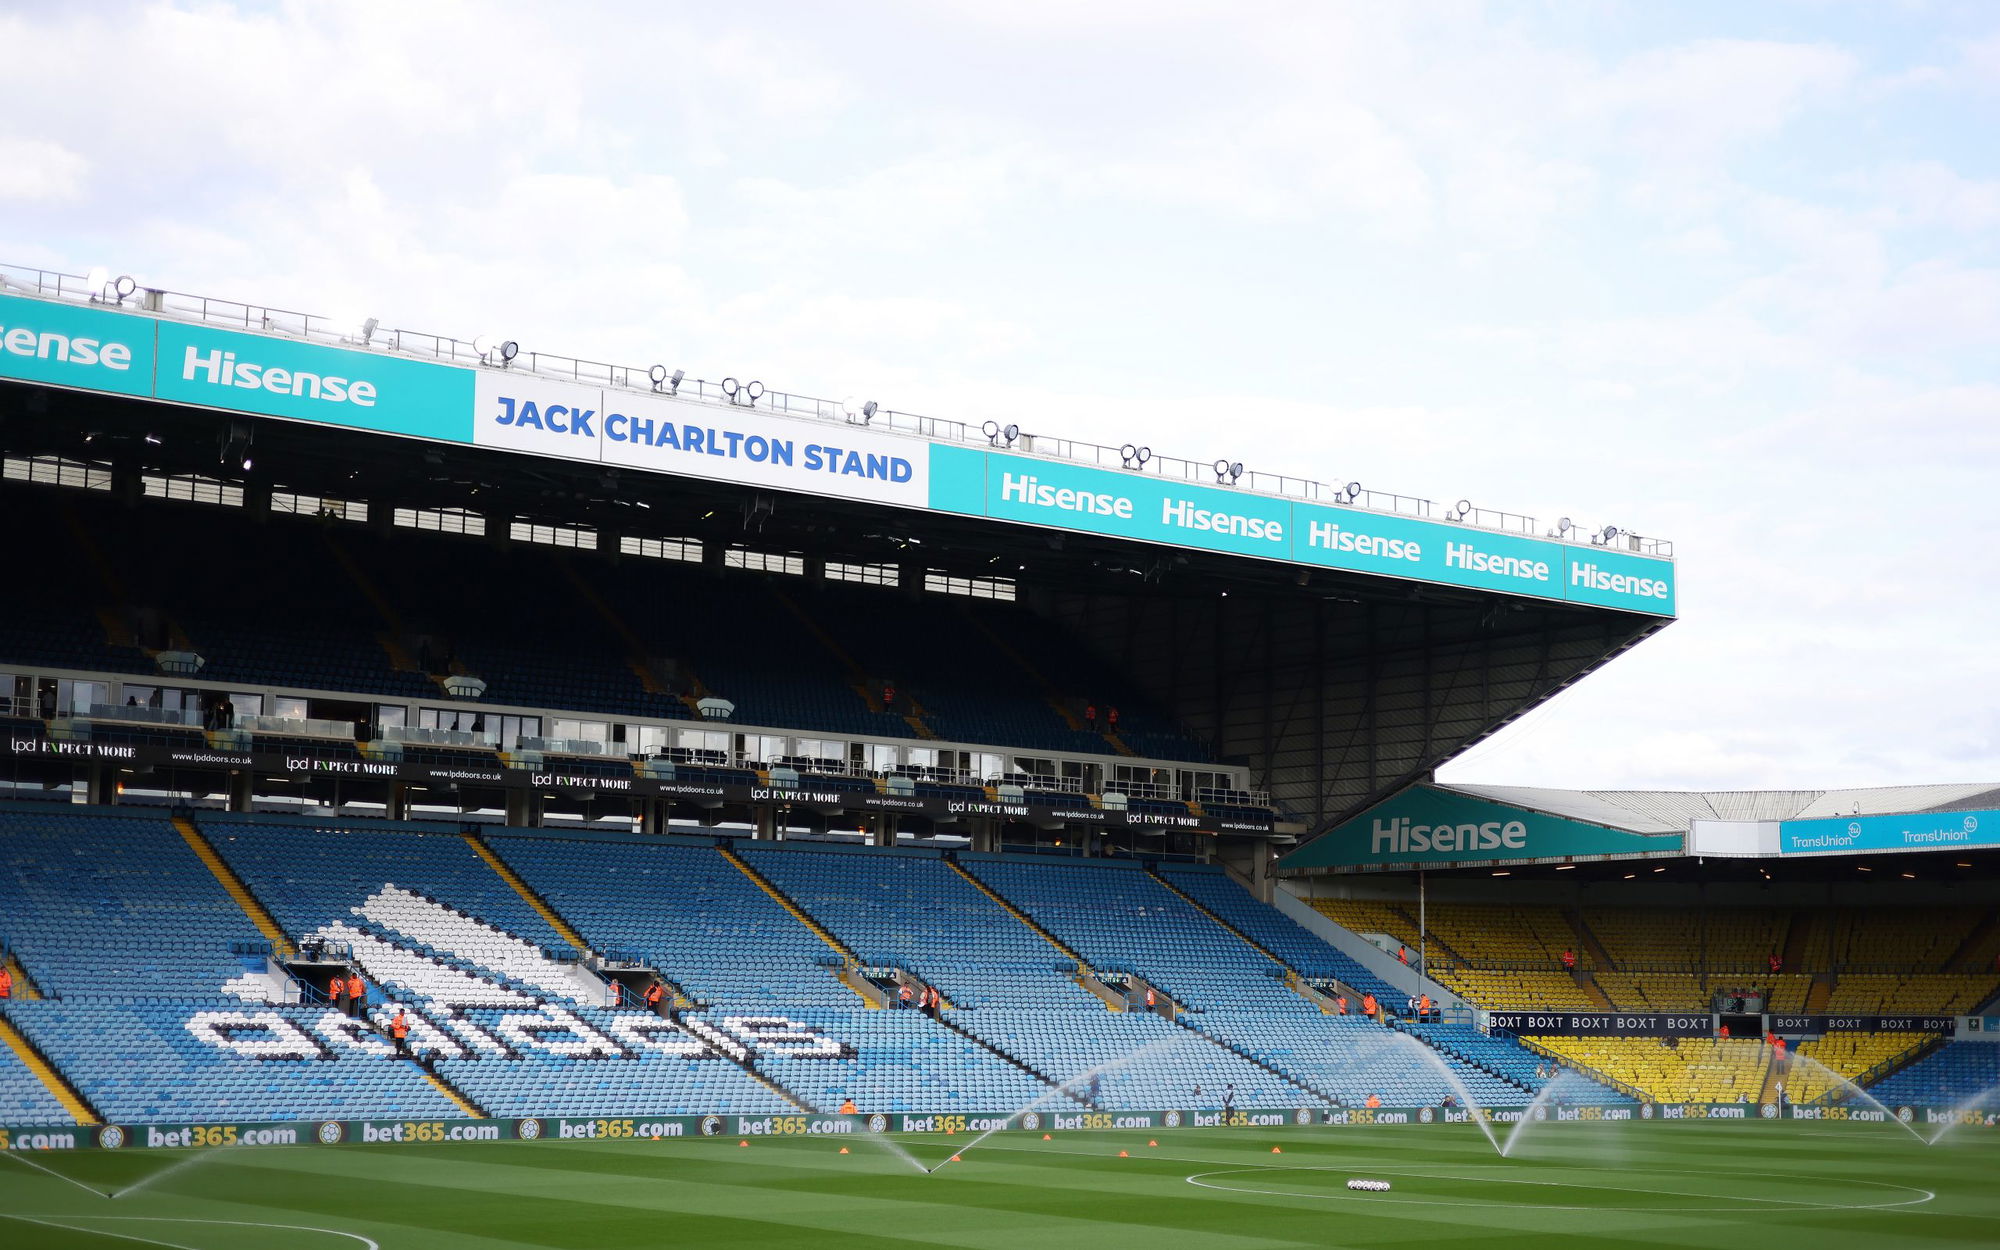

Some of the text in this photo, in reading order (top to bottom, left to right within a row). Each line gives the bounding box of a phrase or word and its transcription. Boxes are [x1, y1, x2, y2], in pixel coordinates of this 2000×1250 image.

[0, 326, 131, 370] ense
[182, 346, 377, 407] Hisense
[496, 397, 912, 483] JACK CHARLTON STAND
[1002, 472, 1133, 519] Hisense
[1161, 497, 1283, 542] Hisense
[1308, 521, 1421, 562] Hisense
[1445, 541, 1549, 582] Hisense
[1571, 561, 1668, 598] Hisense
[98, 746, 136, 759] MORE
[172, 753, 252, 765] www.lpddoors.co.uk
[363, 764, 398, 776] MORE
[430, 769, 501, 781] www.lpddoors.co.uk
[600, 778, 631, 790] MORE
[660, 784, 724, 795] www.lpddoors.co.uk
[812, 793, 841, 803] MORE
[1003, 806, 1029, 816] MORE
[1177, 817, 1200, 827] MORE
[1371, 817, 1527, 854] Hisense
[1792, 836, 1852, 848] TransUnion
[1903, 829, 1968, 843] TransUnion
[1491, 1016, 1709, 1029] BOXT BOXT BOXT BOXT BOXT
[1777, 1018, 1953, 1029] BOXT BOXT BOXT BOXT
[1558, 1107, 1631, 1121] bet365.com
[1663, 1105, 1745, 1119] bet365.com
[1793, 1104, 1885, 1121] bet365.com
[1927, 1107, 2000, 1126] bet365.c
[559, 1119, 683, 1138] bet365.com
[738, 1117, 852, 1135] bet365.com
[903, 1115, 1008, 1132] bet365.com
[1054, 1112, 1150, 1130] bet365.com
[148, 1126, 296, 1147] bet365.com
[363, 1122, 498, 1142] bet365.com
